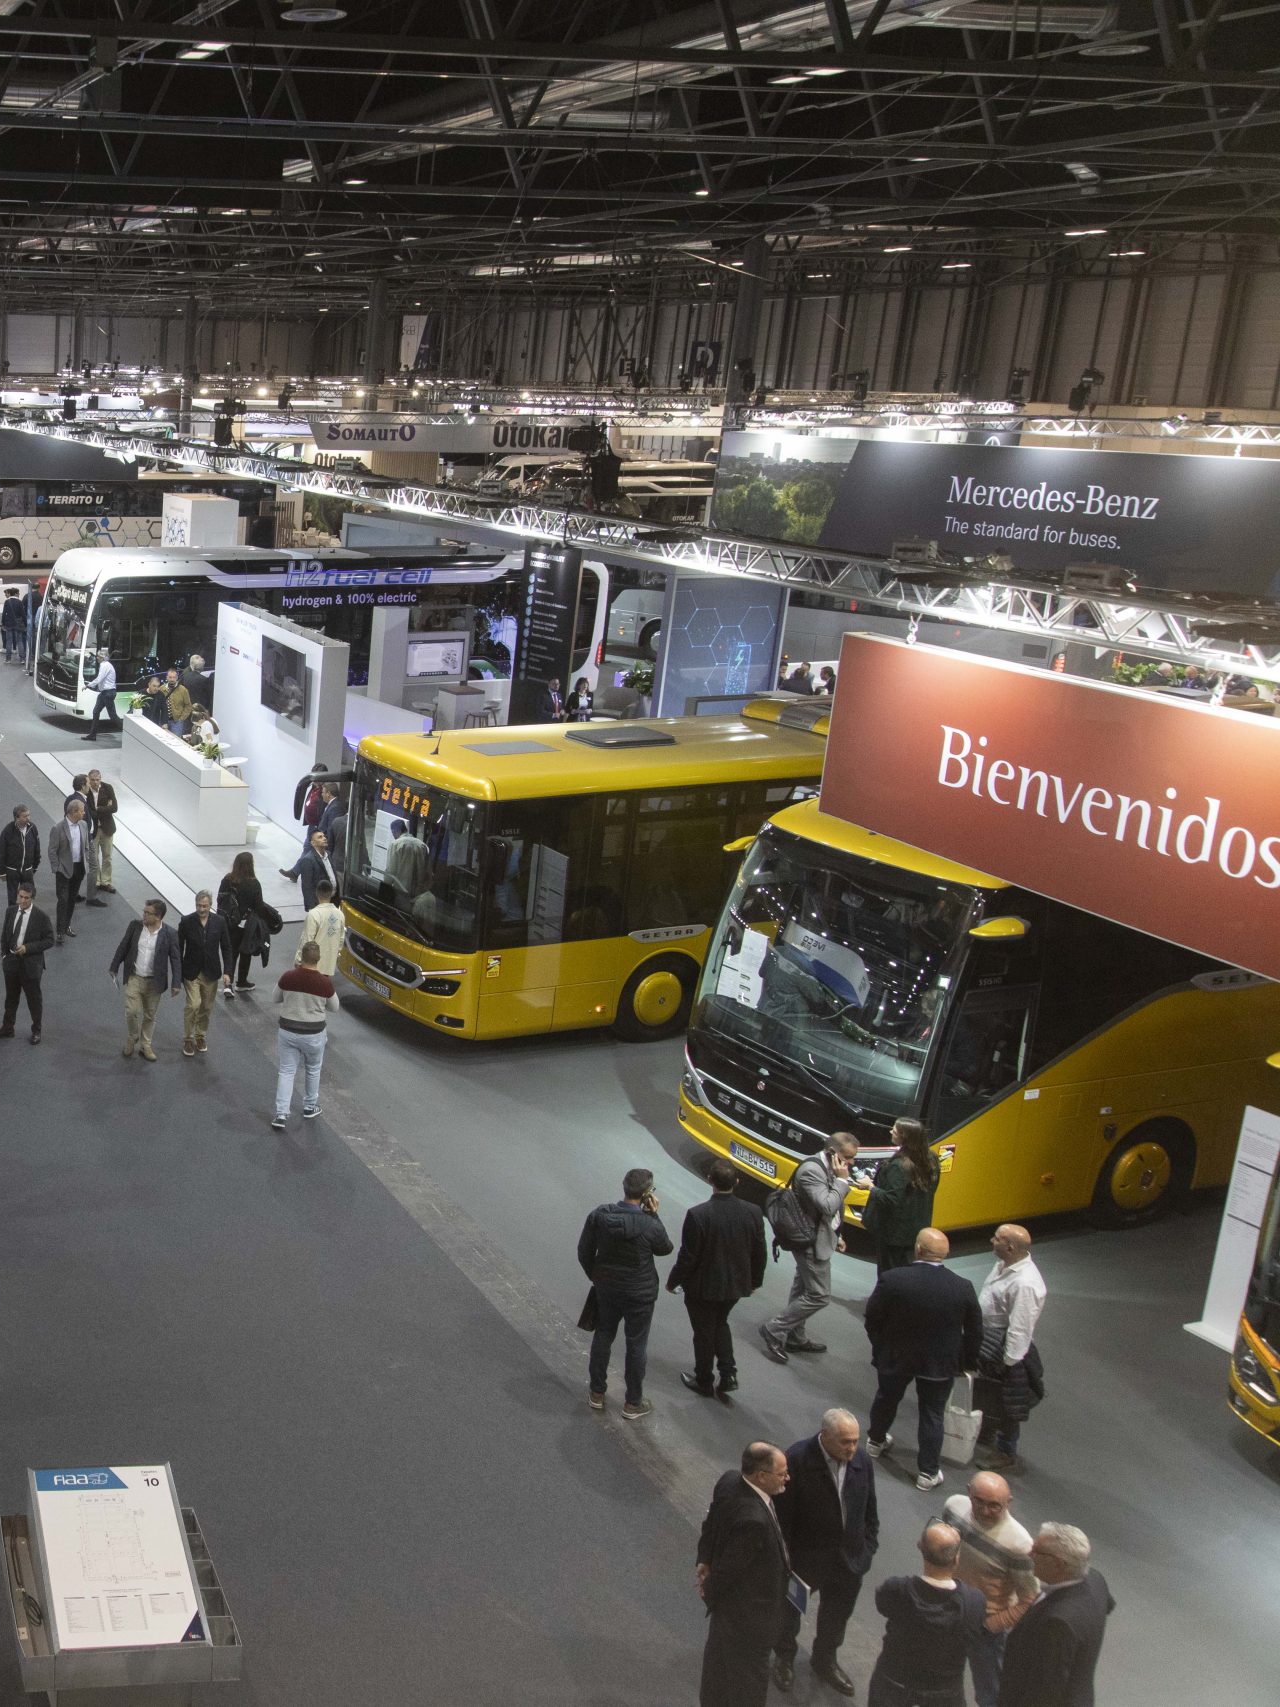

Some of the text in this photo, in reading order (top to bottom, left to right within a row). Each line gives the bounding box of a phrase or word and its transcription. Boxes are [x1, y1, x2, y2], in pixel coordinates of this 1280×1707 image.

[96, 496, 104, 505] U
[946, 475, 1160, 520] Mercedes-Benz
[945, 515, 1121, 550] The standard for buses.
[285, 560, 324, 587] H2
[384, 567, 435, 584] cell
[282, 591, 418, 609] hydrogen & 100% electric
[381, 777, 431, 818] Setra
[937, 724, 1280, 889] Bienvenidos
[641, 928, 695, 939] SETRA
[356, 941, 407, 977] STRA
[718, 1091, 803, 1143] SETRA
[759, 1160, 775, 1175] 515
[143, 1477, 160, 1487] 10
